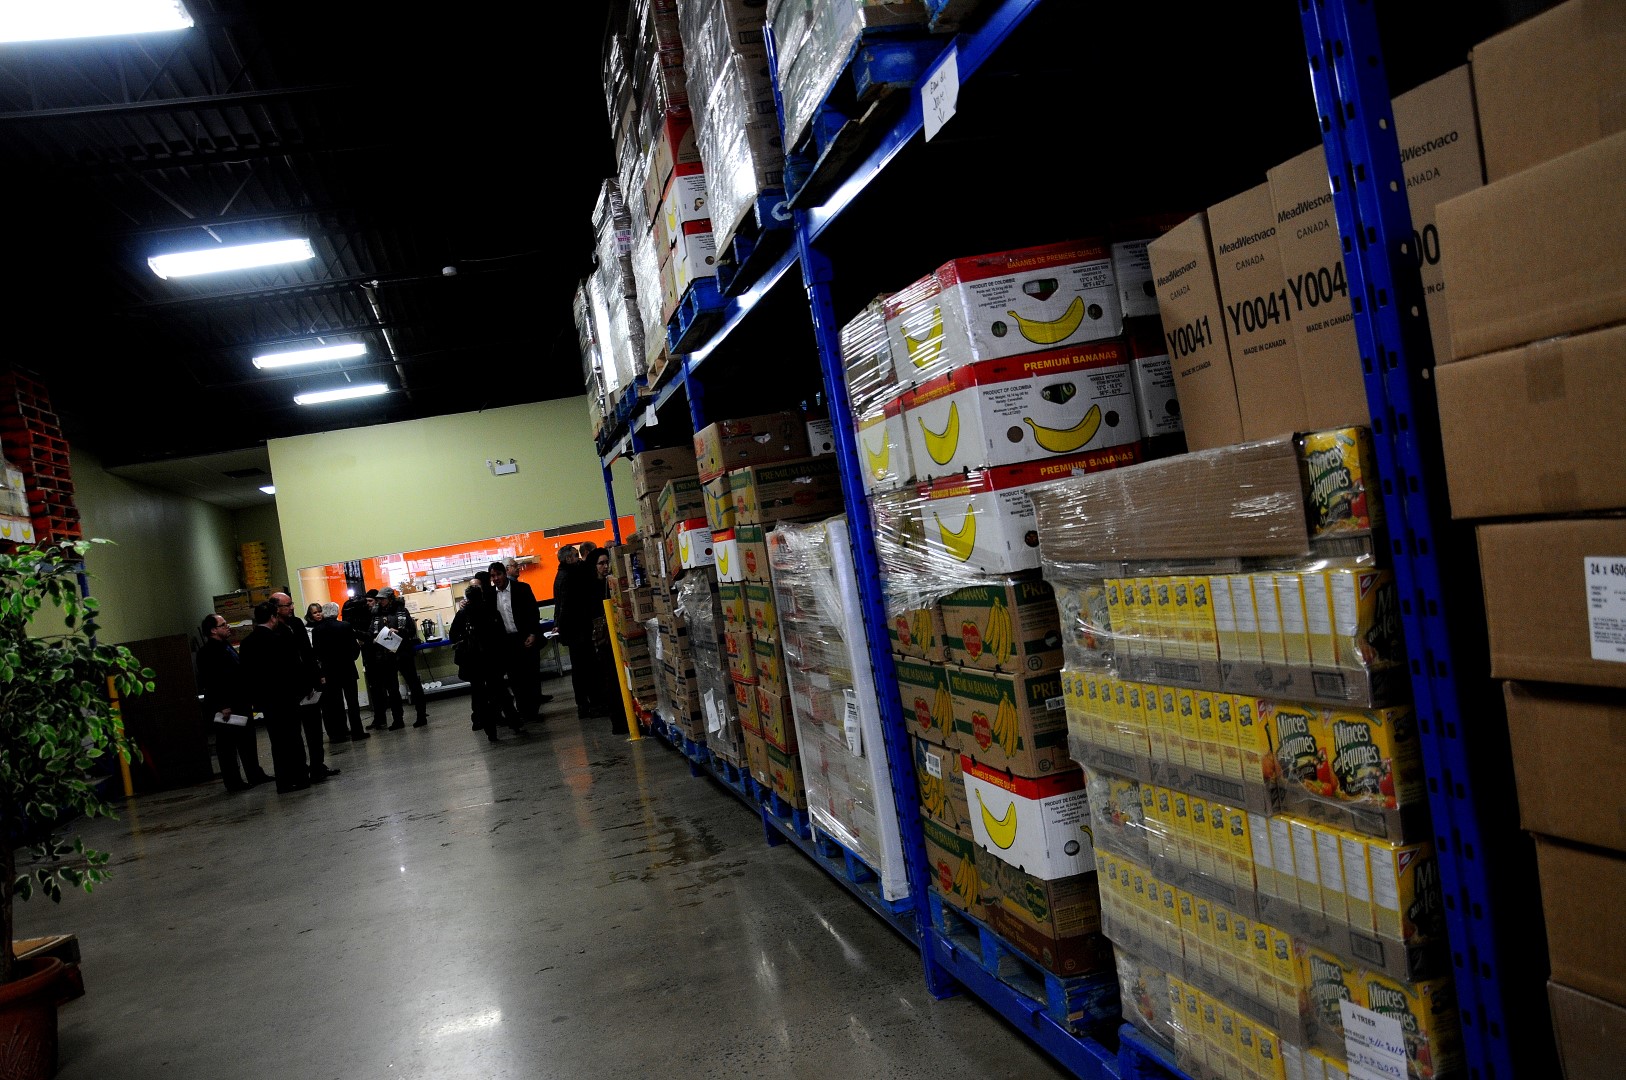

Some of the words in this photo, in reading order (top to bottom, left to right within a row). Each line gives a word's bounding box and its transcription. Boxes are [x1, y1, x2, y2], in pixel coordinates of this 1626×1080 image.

[1407, 167, 1440, 188] ANADA
[1278, 193, 1332, 223] MeadWestva
[1297, 219, 1330, 239] CANADA
[1219, 227, 1276, 256] MeadWestvaco
[1157, 260, 1197, 287] MeadWestvaco
[1235, 254, 1265, 271] CANADA
[1170, 285, 1191, 301] CANADA
[1288, 261, 1347, 311] Y004
[1228, 289, 1291, 335] Y0041
[1167, 315, 1212, 359] Y0041
[1306, 323, 1323, 333] MADE
[1323, 320, 1330, 329] IN
[1244, 345, 1257, 356] MADE
[1257, 344, 1264, 352] IN
[1264, 338, 1286, 350] CANADA
[1024, 355, 1070, 371] PREMIUM
[1073, 351, 1117, 364] BANANAS
[1196, 361, 1212, 372] CANADA
[1040, 459, 1087, 477] PREMIUM
[1088, 451, 1135, 468] BANANAS
[1308, 446, 1343, 486] Minces
[1000, 490, 1019, 498] PRODUCT
[1591, 563, 1599, 575] 24
[1277, 714, 1307, 742] Minces
[1334, 721, 1369, 752] Minces
[1045, 799, 1062, 807] PRODUIT
[1310, 955, 1342, 982] Minces
[1368, 982, 1405, 1010] Minces
[1358, 1014, 1377, 1028] TRIER
